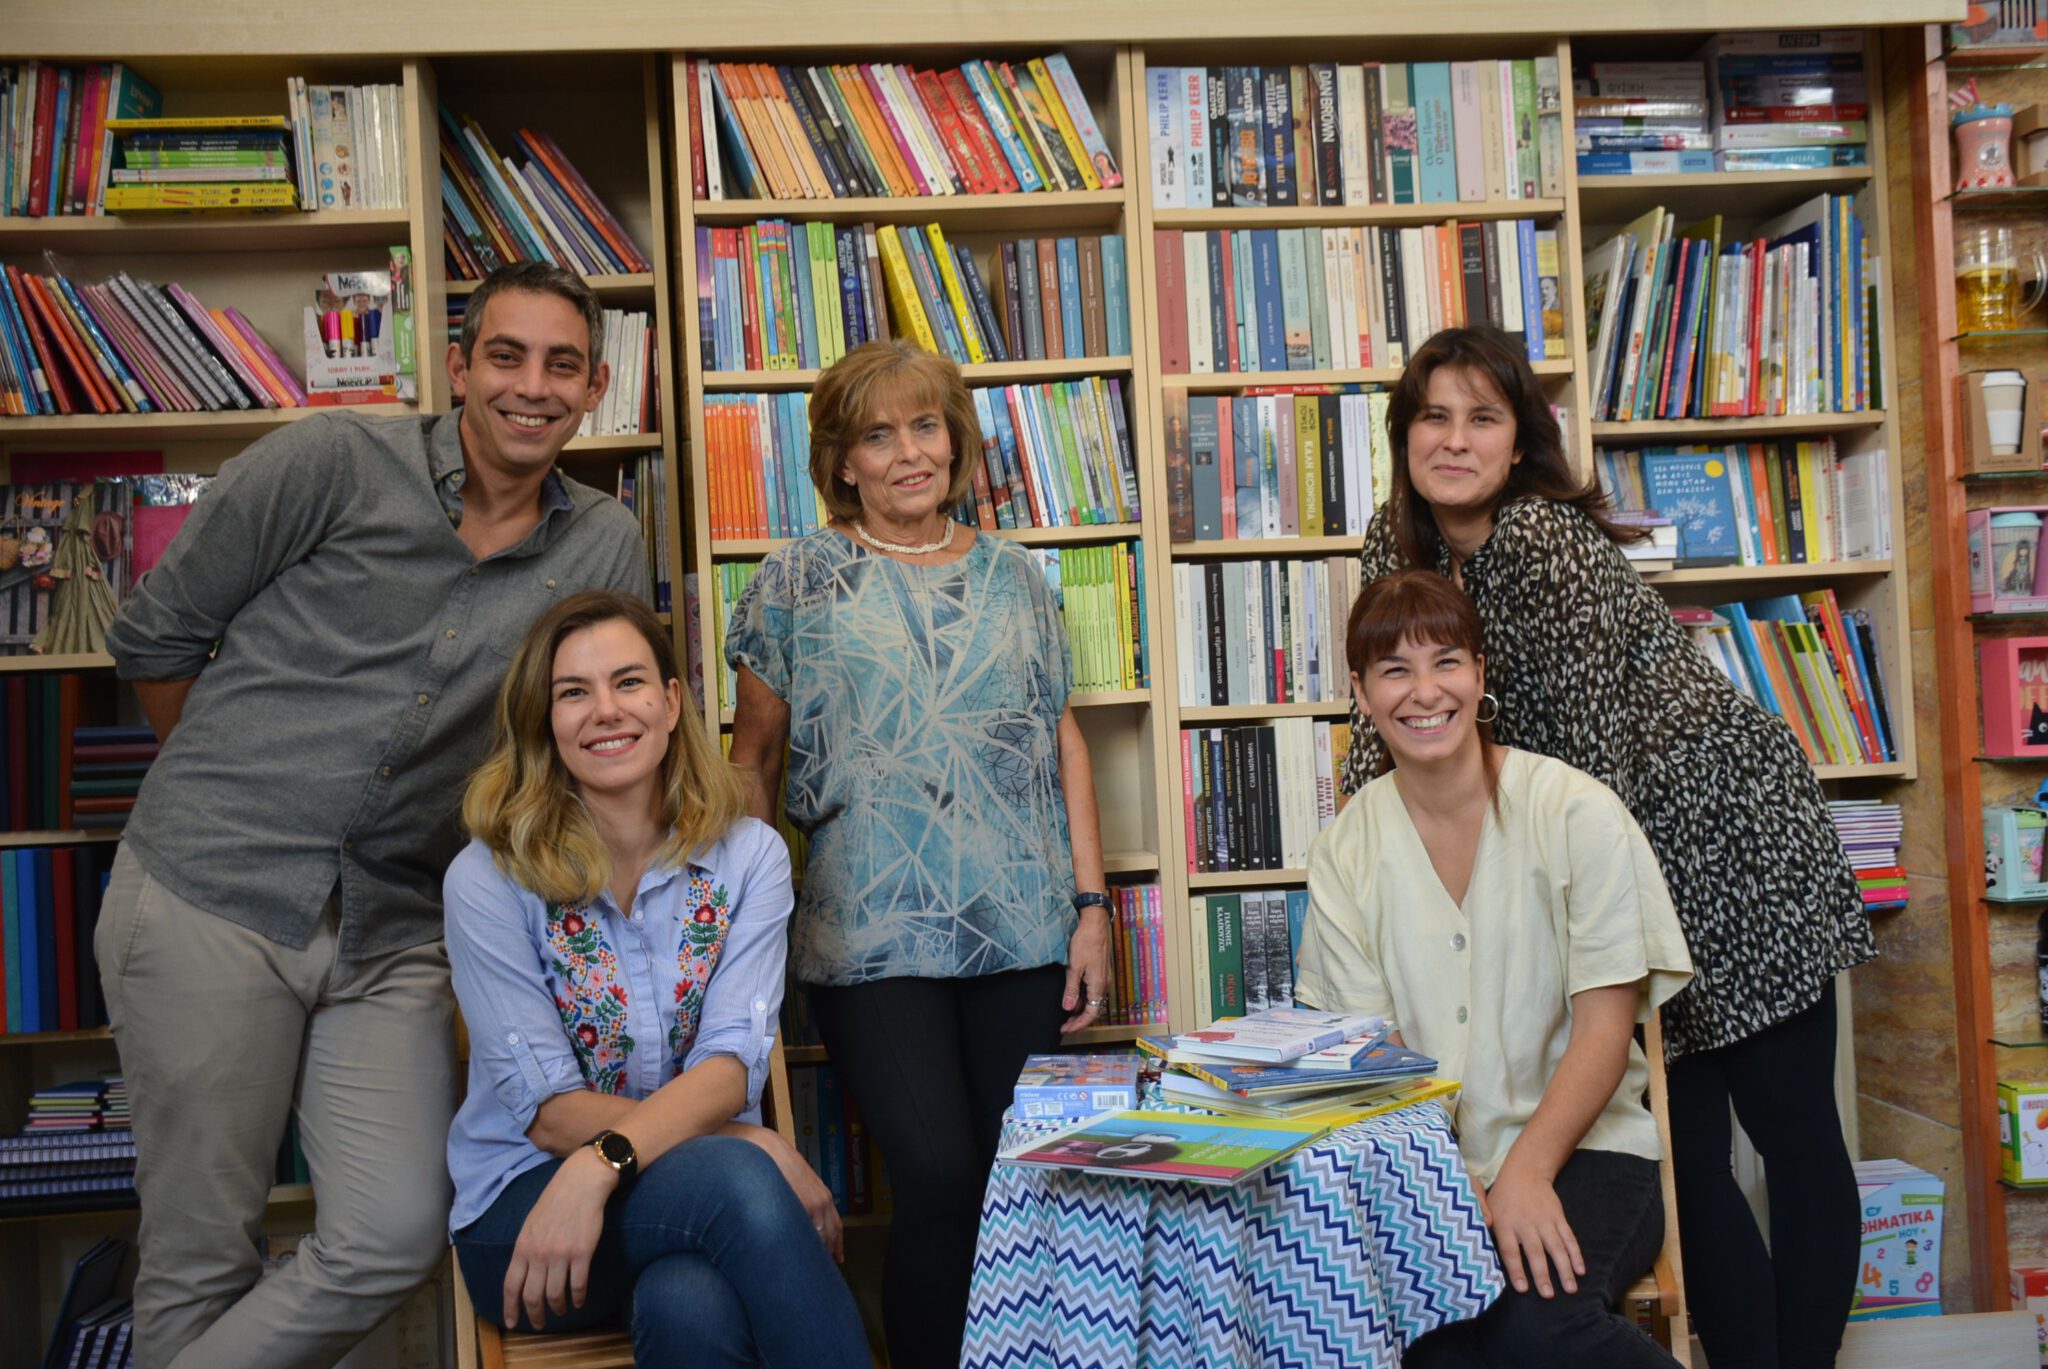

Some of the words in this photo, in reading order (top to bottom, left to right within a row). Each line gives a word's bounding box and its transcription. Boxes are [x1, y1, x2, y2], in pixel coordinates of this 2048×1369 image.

[1157, 74, 1168, 101] KERR
[1188, 75, 1200, 105] KERR
[1319, 70, 1333, 96] DAN
[1161, 104, 1169, 137] PHILIP
[1190, 109, 1202, 147] PHILIP
[1321, 97, 1335, 142] BROWN
[1304, 441, 1314, 468] ΚΑΛΗ
[16, 491, 66, 513] Vintage
[1305, 473, 1316, 520] ΚΟΙΝΩΝΙΑ
[1217, 907, 1225, 952] ΚΑΛΠΟΥΖΟΣ
[1224, 912, 1232, 945] ΓΙΑΝΝΗΣ
[1861, 1210, 1935, 1235] ΘΗΜΑΤΙΚΑ
[1877, 1248, 1885, 1259] 2
[1923, 1240, 1933, 1251] 3
[1862, 1262, 1882, 1288] 4
[1889, 1280, 1899, 1295] 5
[1915, 1272, 1934, 1293] 8
